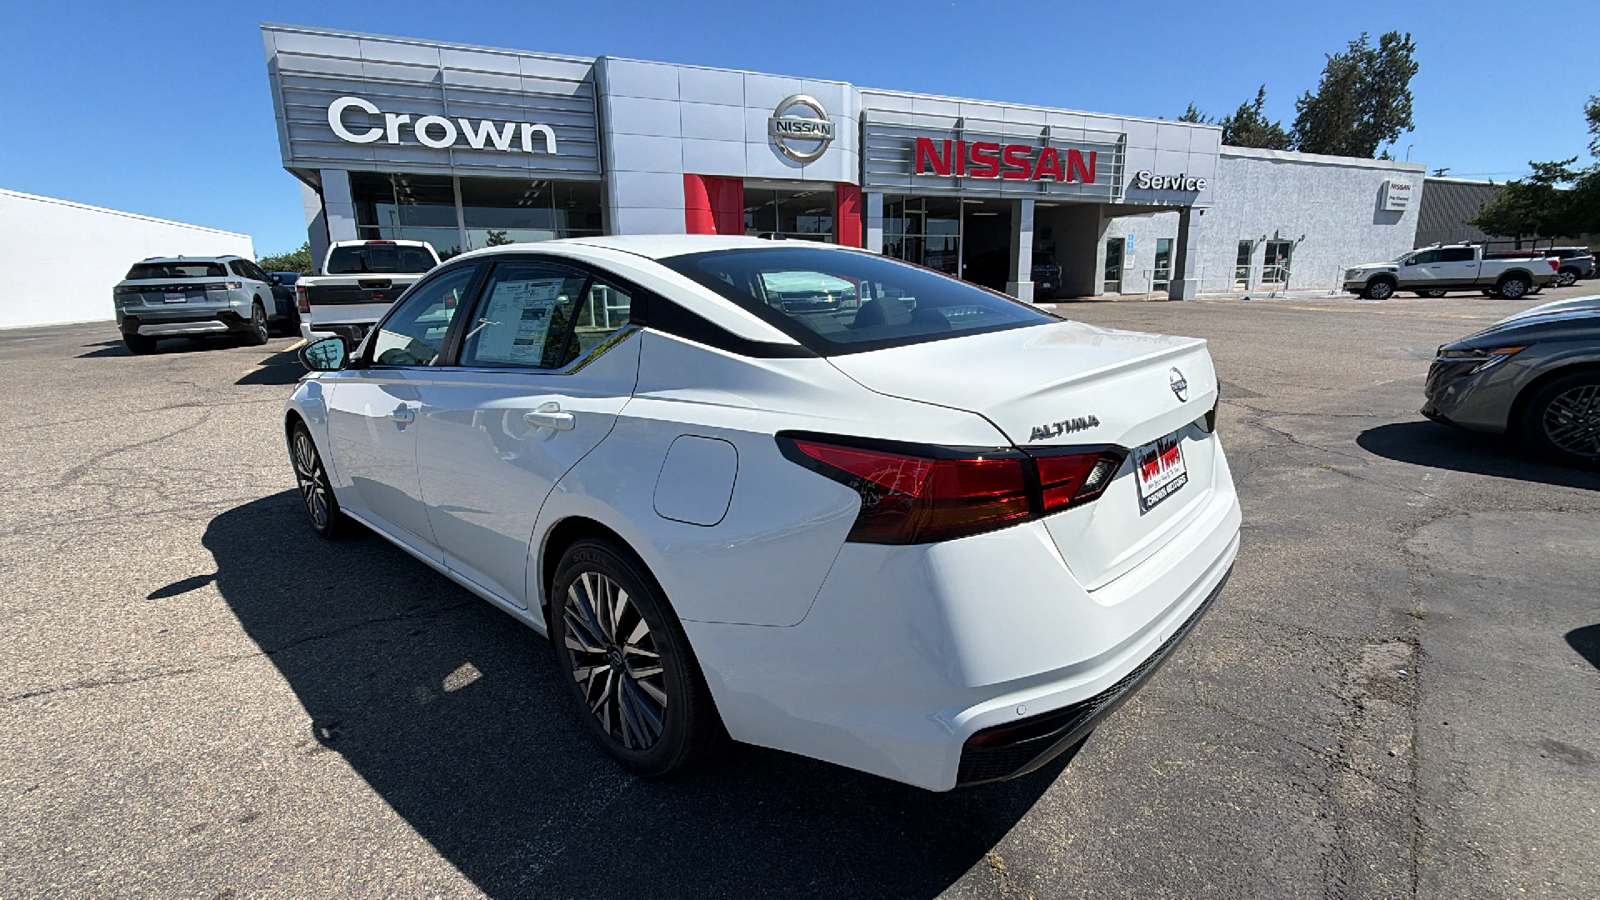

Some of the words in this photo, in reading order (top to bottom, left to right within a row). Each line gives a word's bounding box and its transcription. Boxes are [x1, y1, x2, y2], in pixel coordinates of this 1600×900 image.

[327, 96, 557, 154] Crown
[776, 121, 830, 135] NISSAN
[915, 137, 1097, 184] NISSAN
[1137, 170, 1207, 191] Service
[1028, 414, 1100, 443] ALTIMA
[1147, 486, 1167, 506] CROWN
